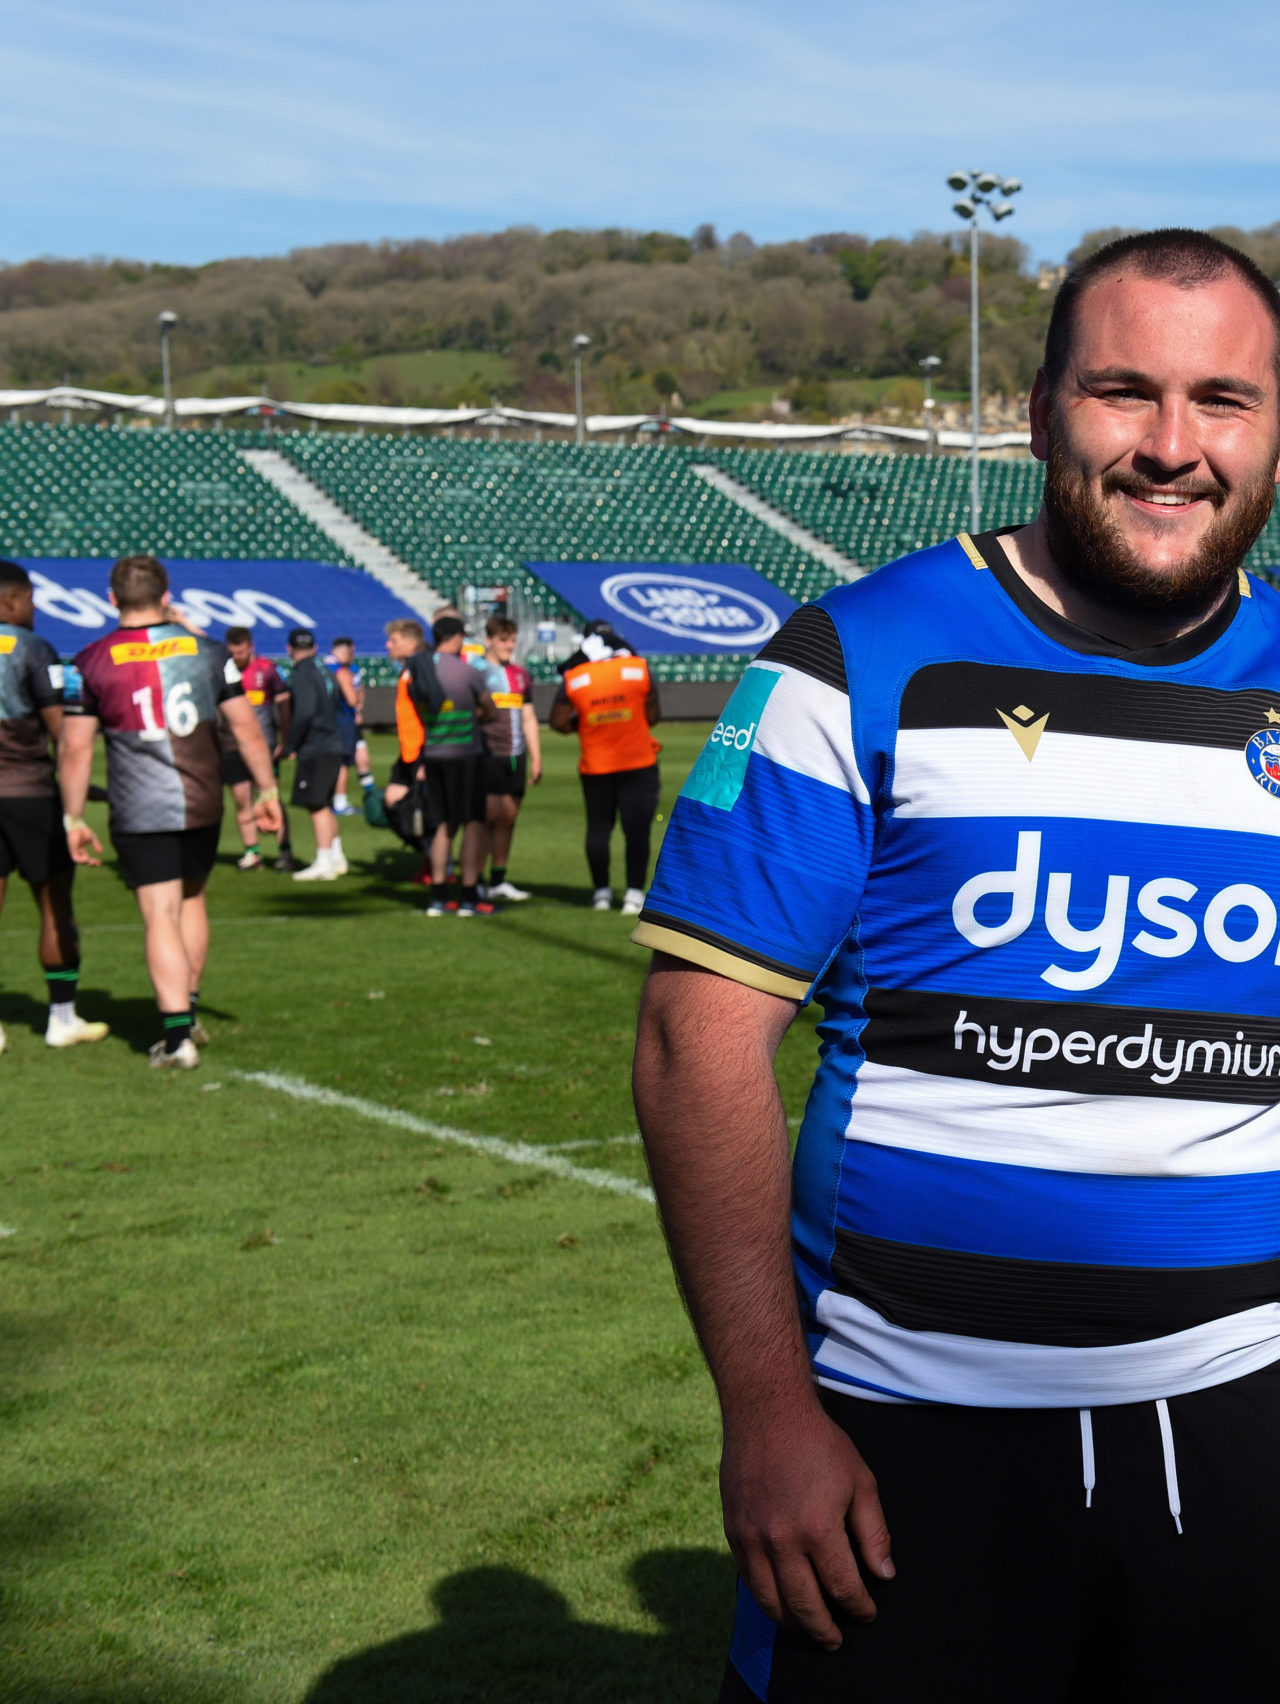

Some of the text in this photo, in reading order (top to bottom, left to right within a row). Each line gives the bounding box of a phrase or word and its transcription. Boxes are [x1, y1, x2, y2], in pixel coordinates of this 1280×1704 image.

[29, 570, 318, 628] don
[629, 587, 707, 607] LAND
[663, 606, 756, 627] ROVER
[132, 680, 199, 741] 16
